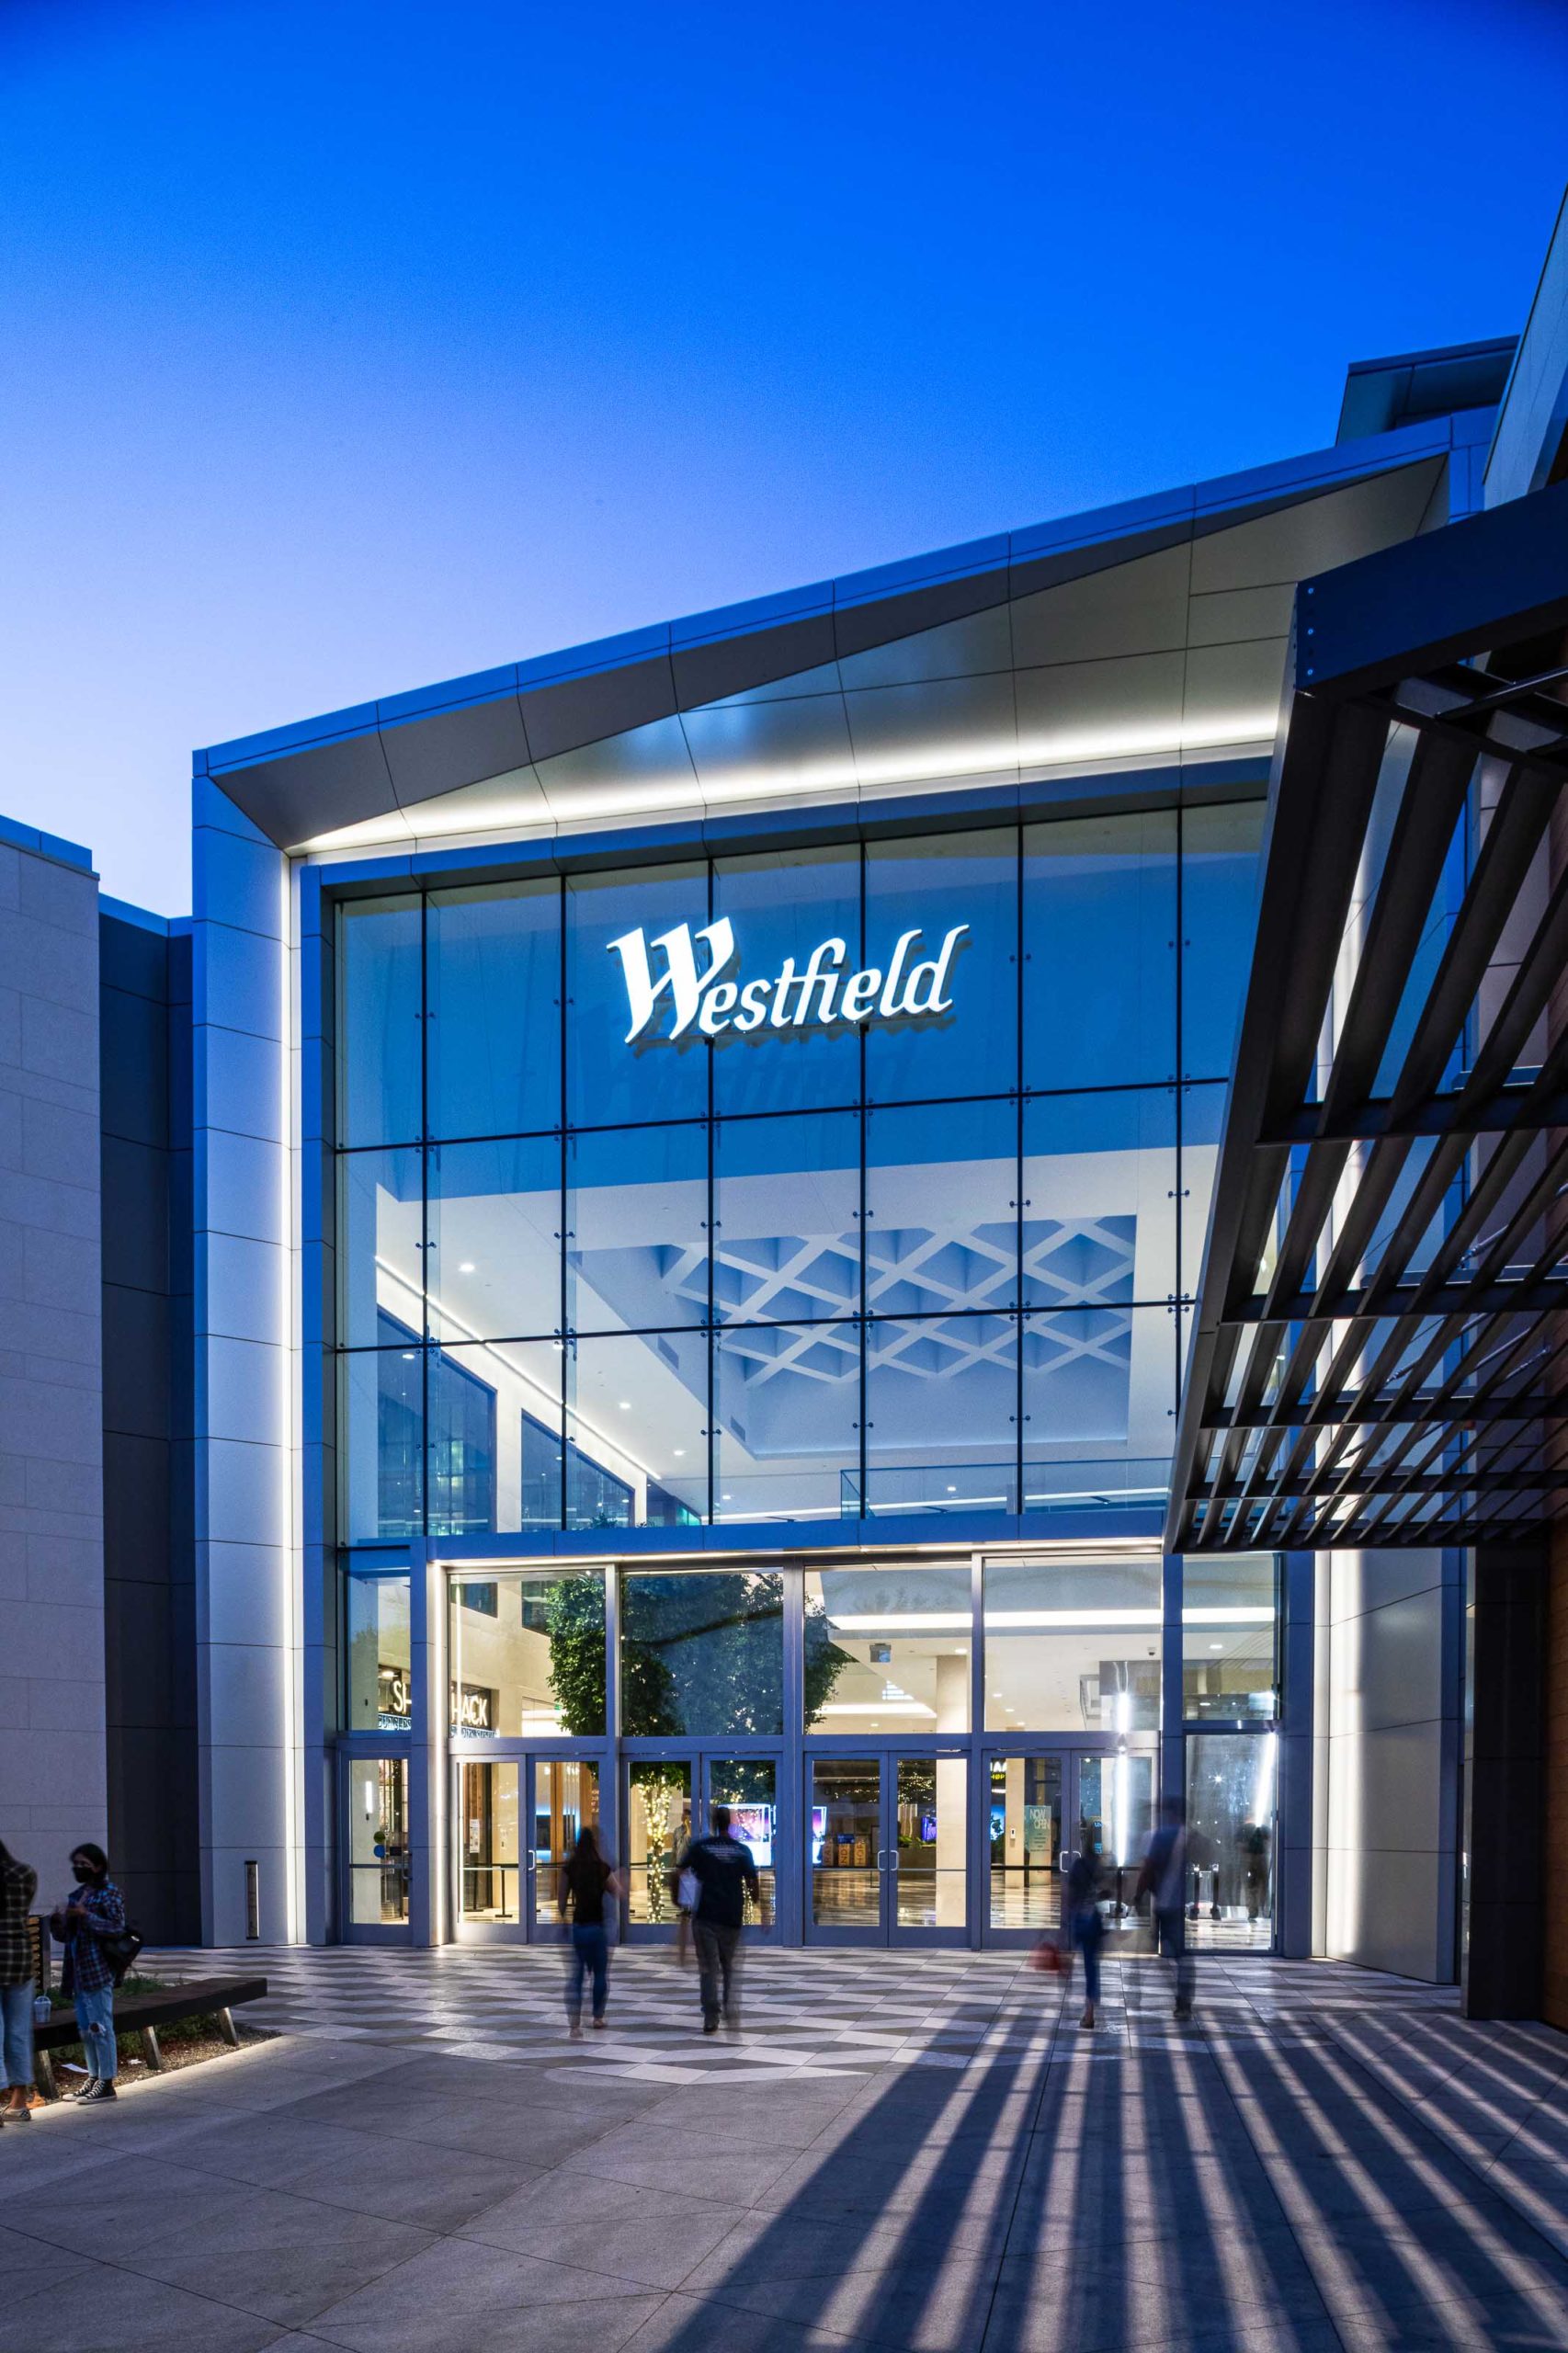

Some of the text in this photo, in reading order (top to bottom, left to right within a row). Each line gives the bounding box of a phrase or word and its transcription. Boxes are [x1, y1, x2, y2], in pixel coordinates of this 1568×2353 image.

[606, 916, 970, 1044] Westfield
[450, 1691, 488, 1727] HACK
[1029, 1809, 1046, 1819] NOW
[1034, 1819, 1051, 1830] OPEN
